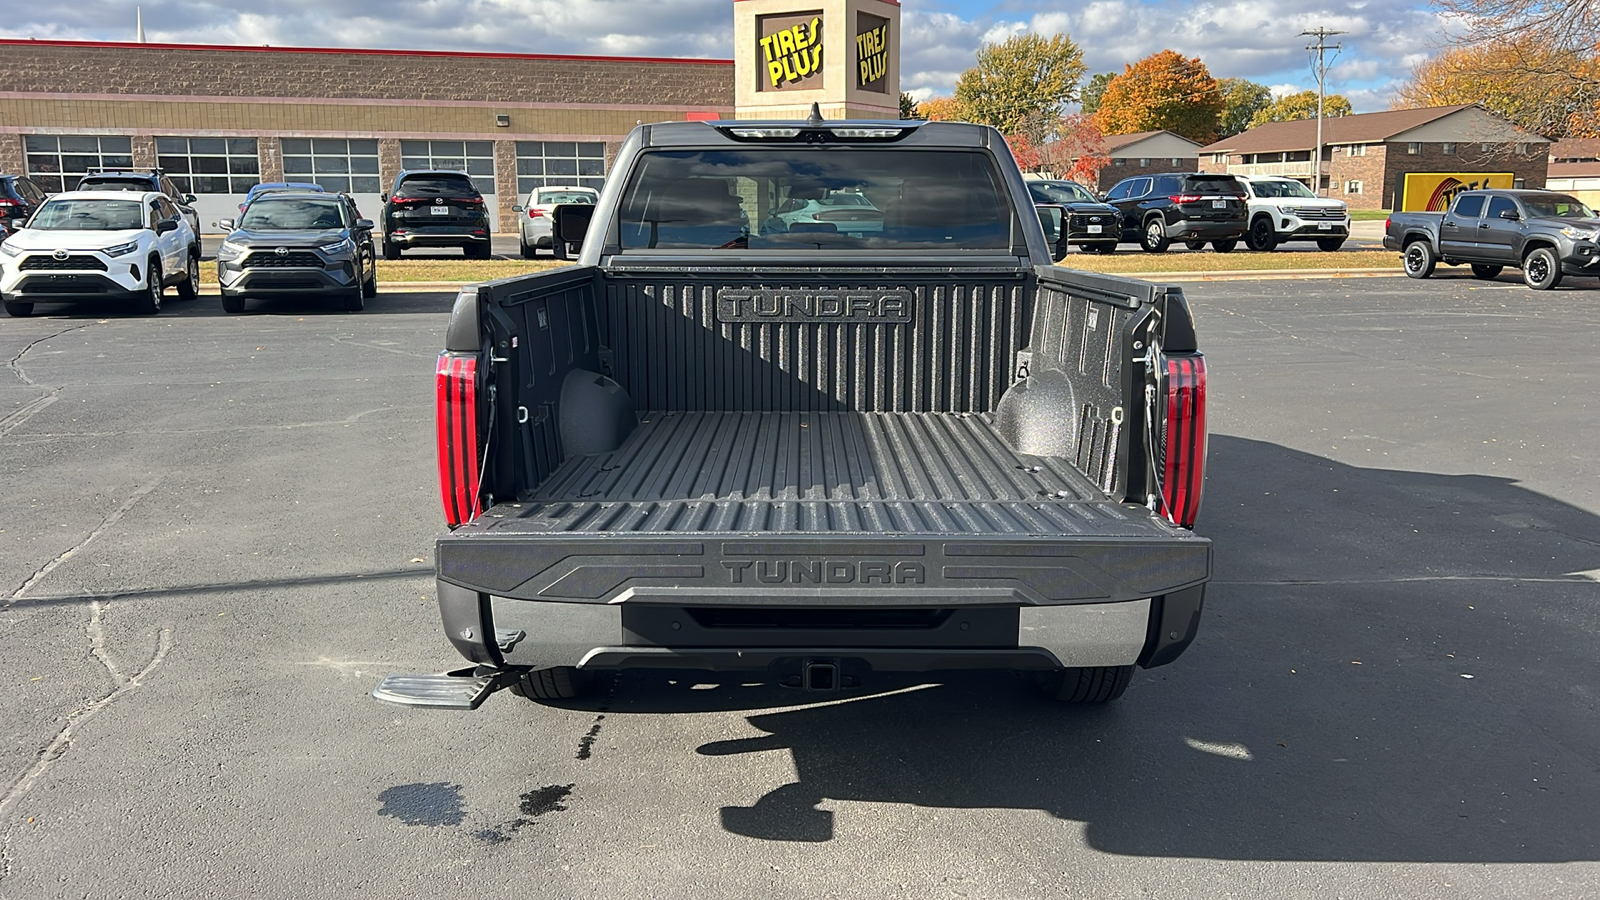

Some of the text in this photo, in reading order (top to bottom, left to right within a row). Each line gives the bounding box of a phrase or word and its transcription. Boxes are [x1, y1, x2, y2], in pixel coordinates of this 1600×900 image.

[759, 17, 820, 61] TIRES
[856, 25, 887, 60] TIRES
[767, 43, 823, 87] PLUS
[859, 51, 888, 86] PLUS
[722, 295, 906, 317] TUNDRA
[720, 560, 926, 584] TUNDRA
